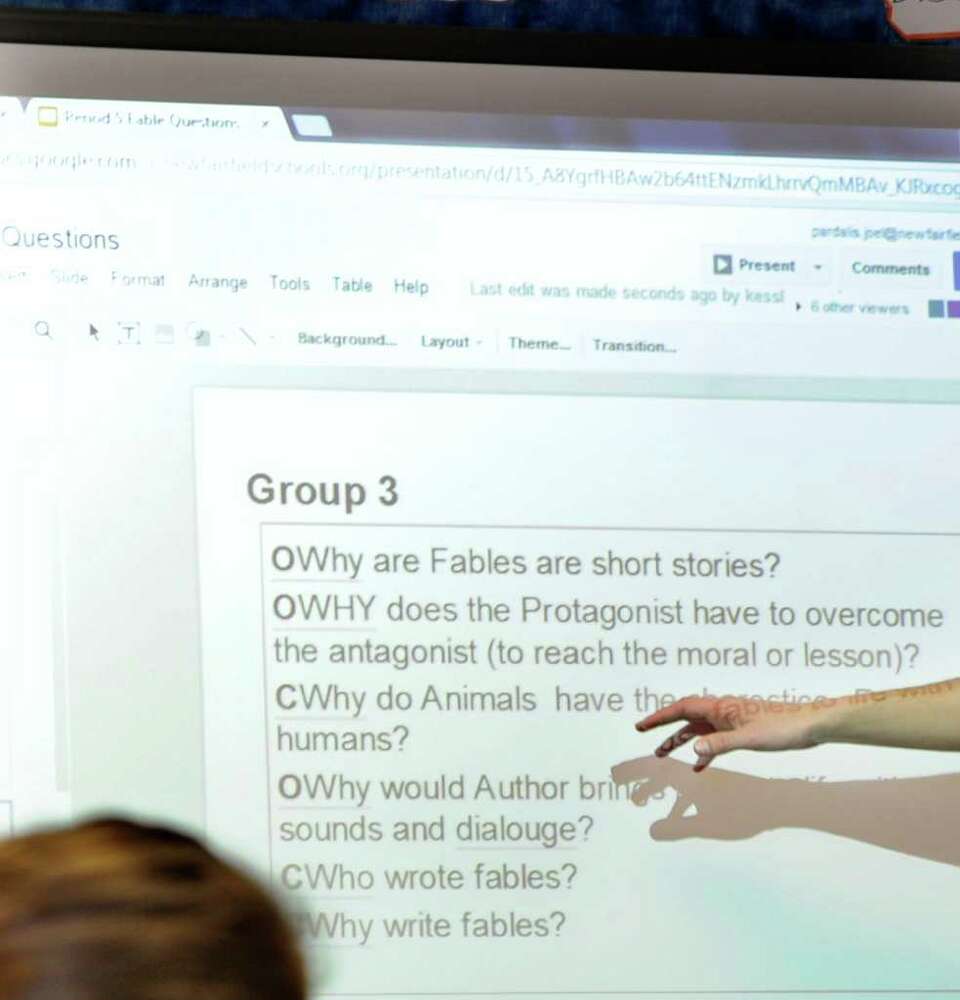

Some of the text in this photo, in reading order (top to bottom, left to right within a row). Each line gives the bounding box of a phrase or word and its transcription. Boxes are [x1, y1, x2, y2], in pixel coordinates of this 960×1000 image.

[2, 225, 120, 250] Questions
[739, 258, 795, 275] Present
[852, 262, 930, 277] Comments
[112, 270, 165, 287] Format
[188, 274, 248, 293] Arrange
[270, 274, 310, 292] Tools
[334, 276, 373, 293] Table
[394, 279, 429, 296] Help
[470, 280, 502, 297] Last
[509, 283, 535, 297] edit
[541, 287, 570, 298] was
[576, 284, 616, 299] made
[623, 286, 685, 301] seconds
[691, 291, 716, 304] ago
[722, 288, 740, 305] by
[811, 301, 909, 315] 6 other viewers
[421, 334, 469, 350] Layout
[247, 473, 399, 514] Group 3
[272, 546, 780, 578] OWhy are Fables are short stories?
[273, 594, 944, 630] OWHY does the Protagonist have to overcome
[274, 637, 919, 674] the antagonist (to reach the moral or lesson)?
[275, 684, 366, 717] CWhy
[376, 685, 412, 712] do
[421, 686, 537, 712] Animals
[555, 686, 624, 713] have
[277, 724, 409, 752] humans?
[278, 774, 370, 807] OWhy
[380, 774, 465, 801] would
[474, 774, 569, 802] Author
[279, 815, 594, 848] sounds and dialouge?
[281, 863, 577, 891] CWho wrote fables?
[304, 911, 565, 946] Why write fables?
